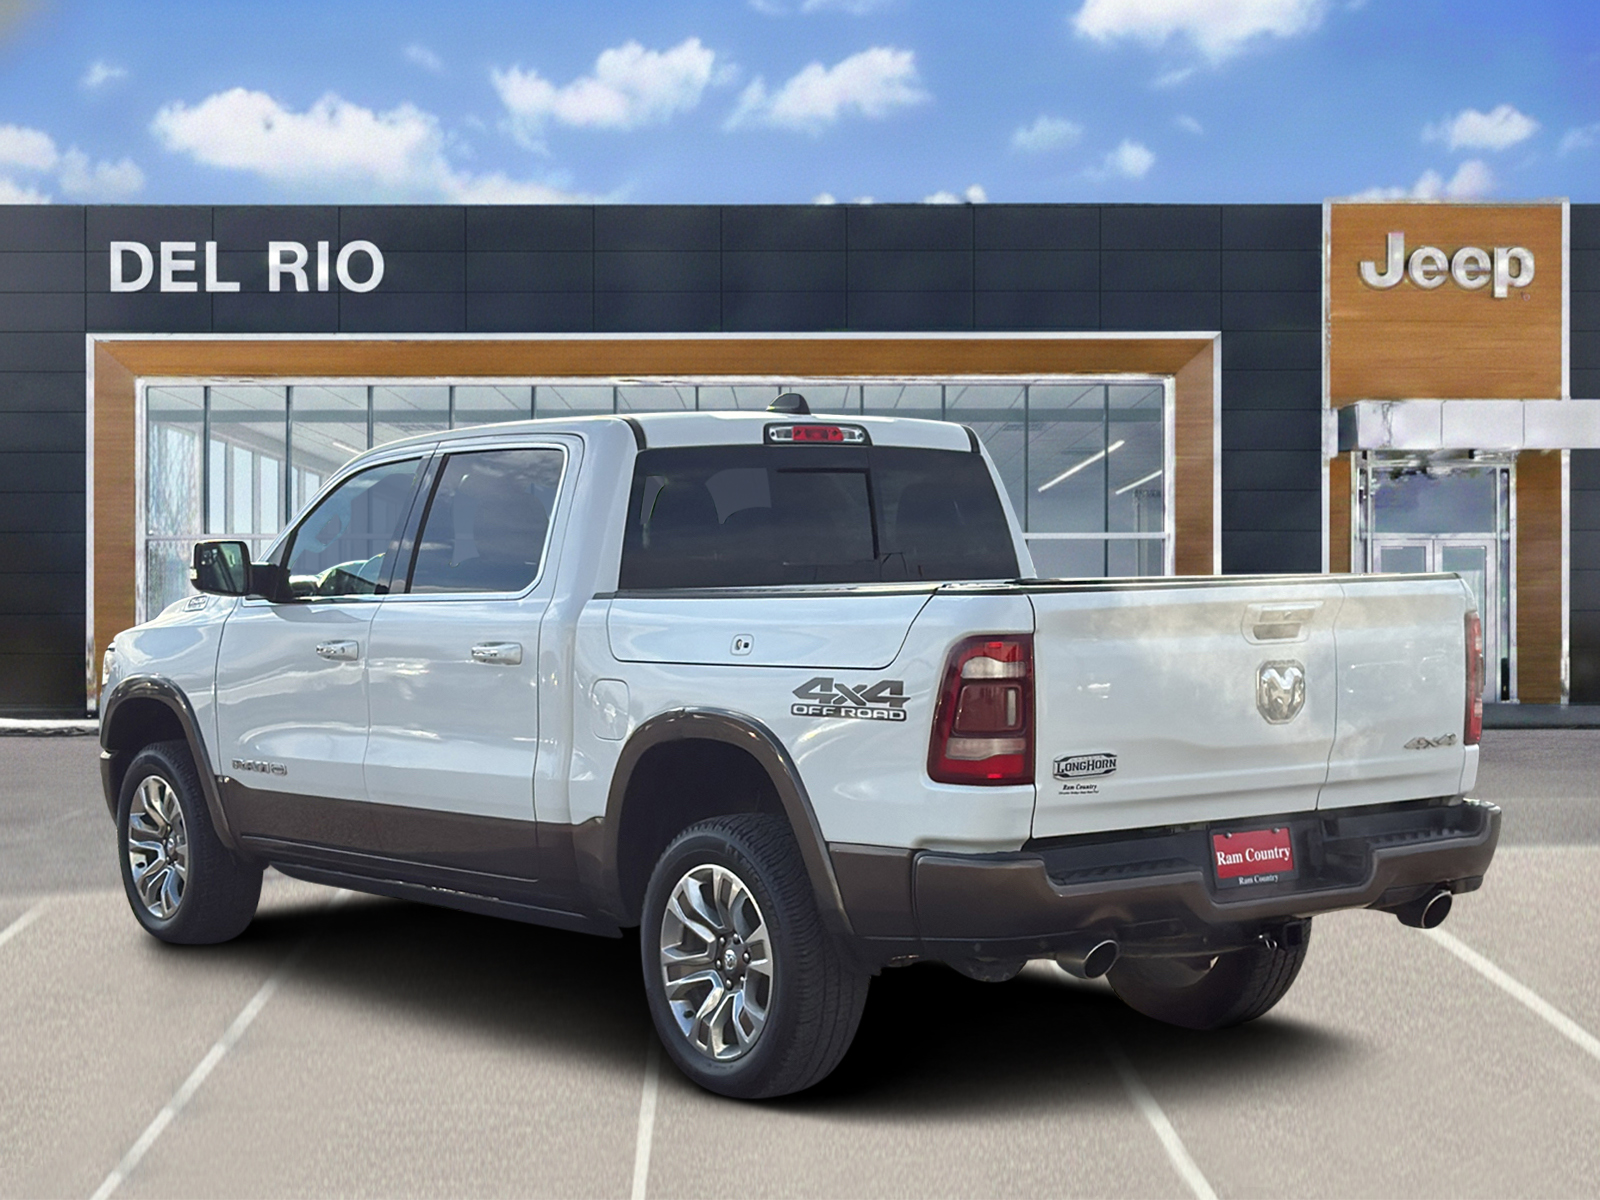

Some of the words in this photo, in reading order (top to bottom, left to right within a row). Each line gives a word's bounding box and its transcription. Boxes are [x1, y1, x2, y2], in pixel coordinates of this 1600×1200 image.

[110, 241, 240, 292] DEL
[268, 240, 385, 293] RIO
[1360, 231, 1535, 298] Jeep
[793, 705, 835, 715] OFF
[841, 708, 905, 720] ROAD
[1217, 851, 1243, 866] Ram
[1245, 846, 1290, 862] Country
[1238, 876, 1254, 885] Ram
[1254, 874, 1278, 883] Country
